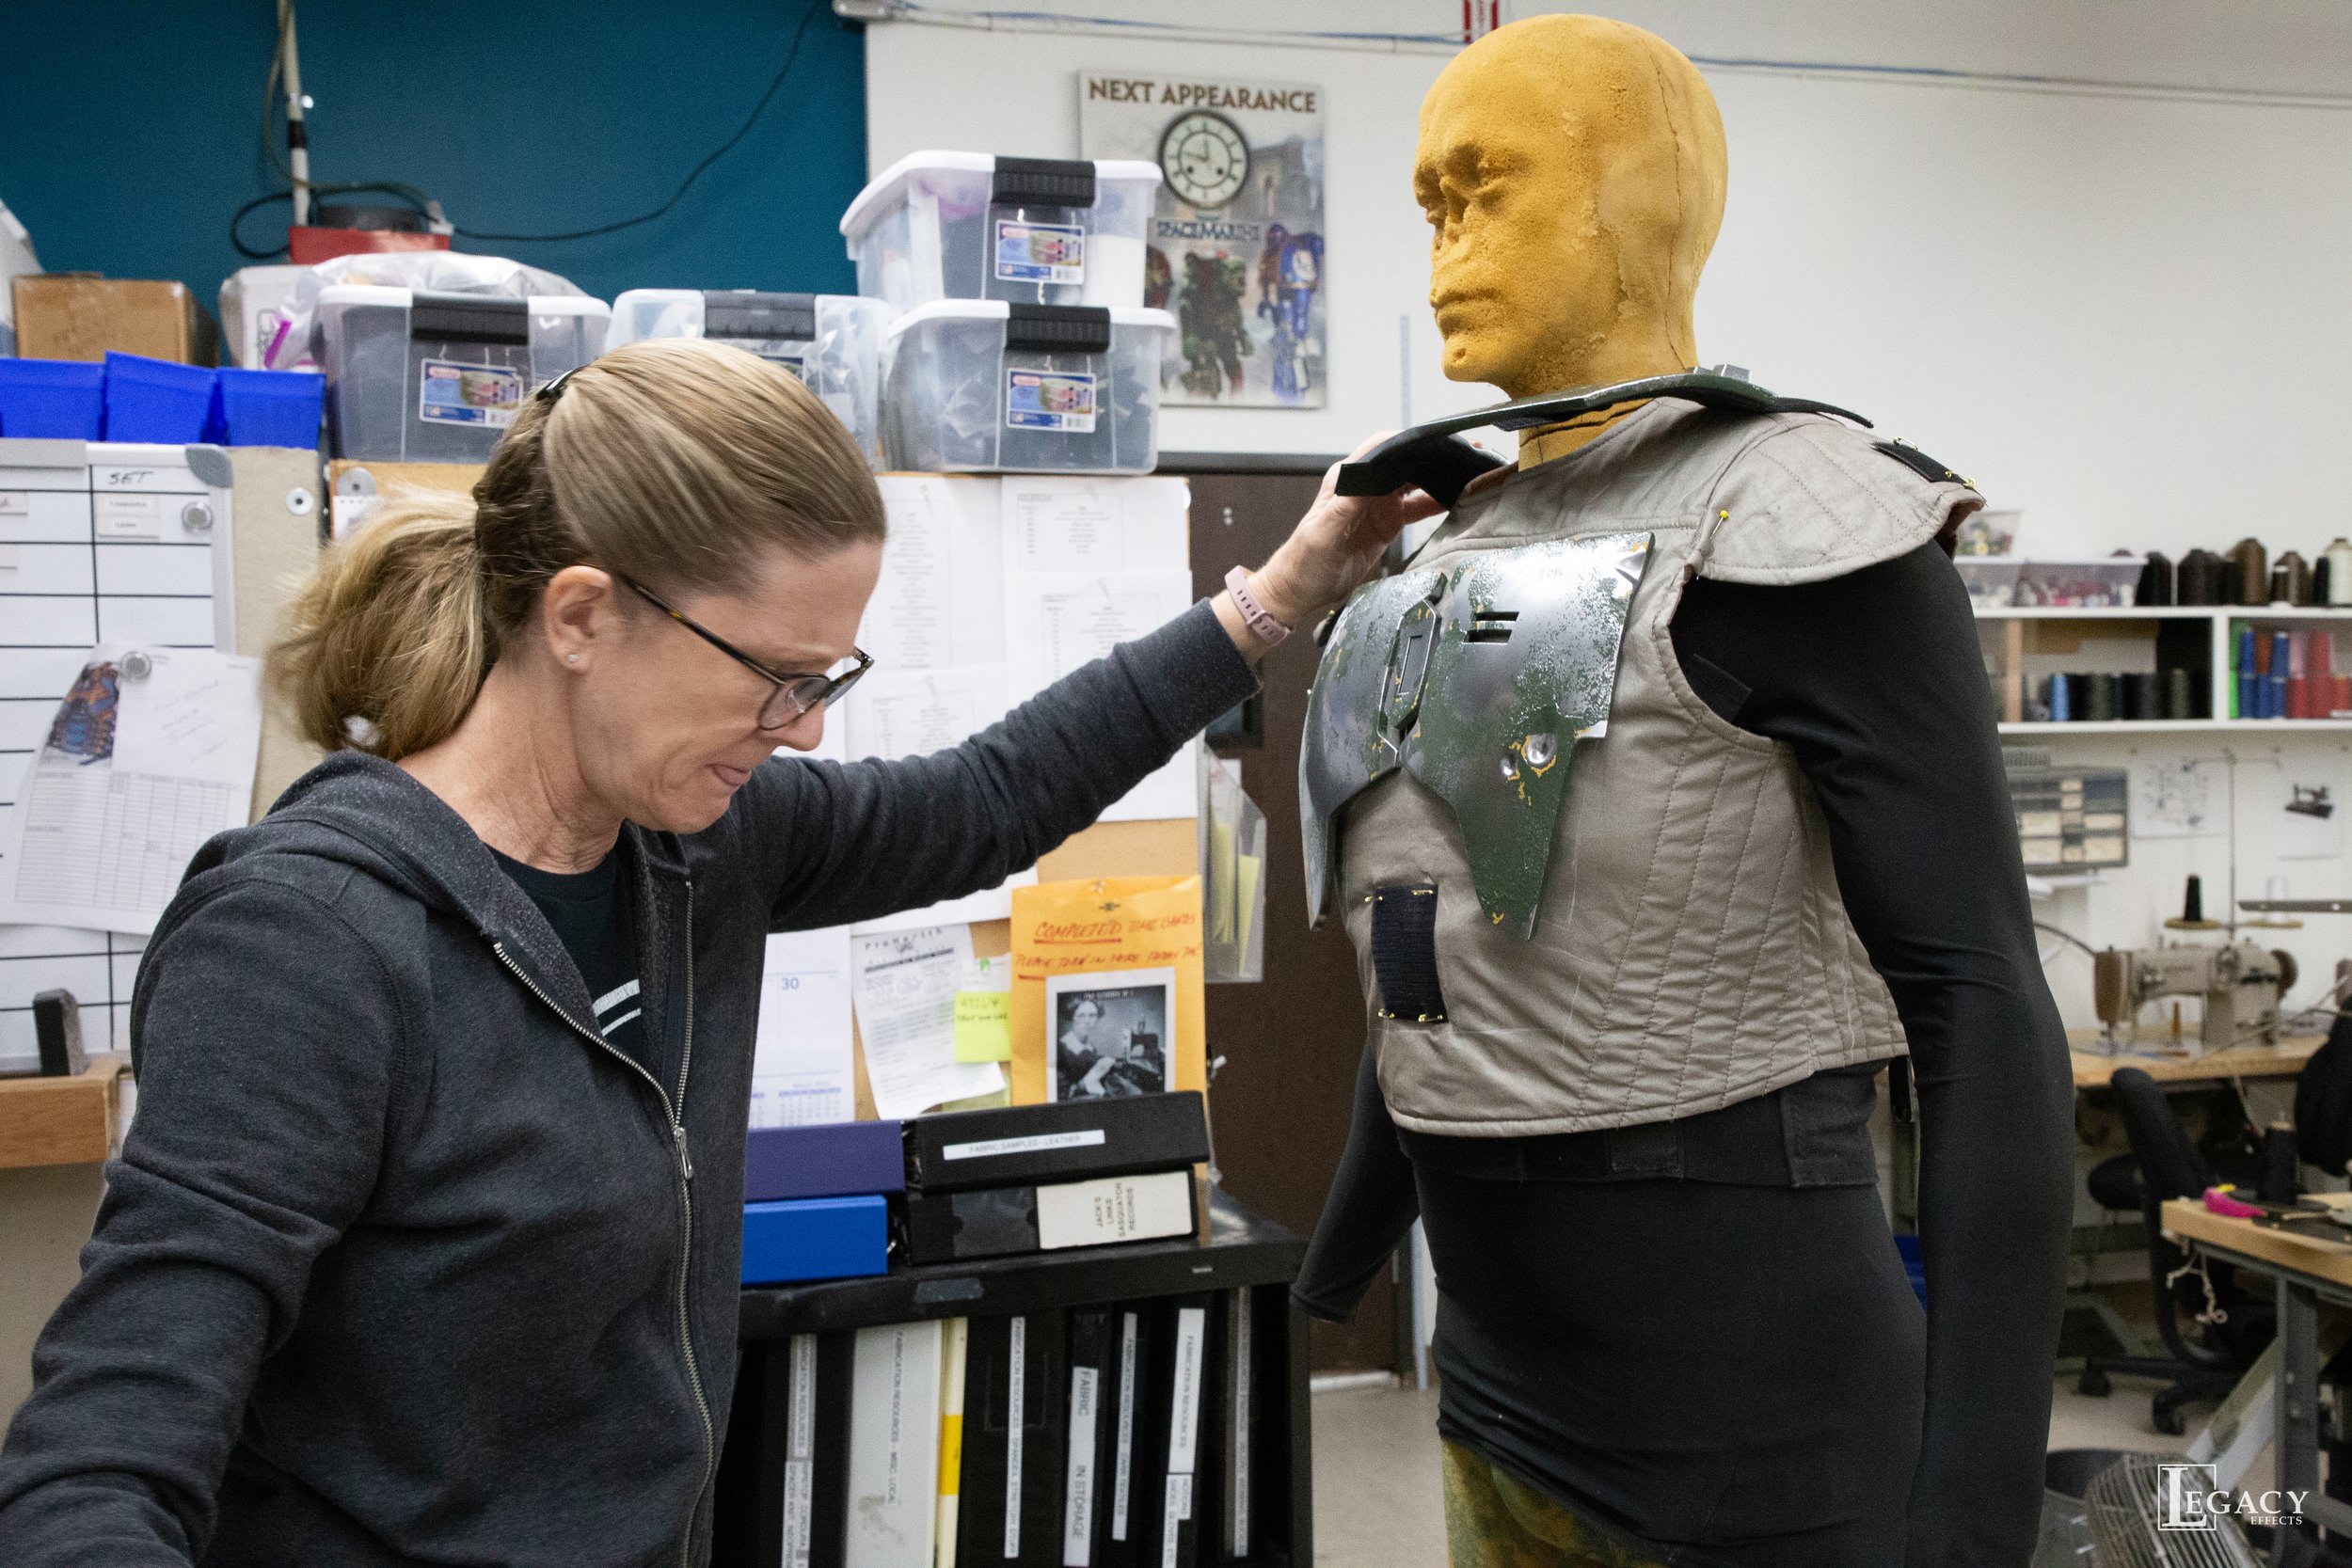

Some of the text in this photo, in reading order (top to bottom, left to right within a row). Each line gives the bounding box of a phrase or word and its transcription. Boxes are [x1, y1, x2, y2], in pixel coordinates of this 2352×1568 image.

[1089, 79, 1316, 113] NEXT APPEARANCE
[108, 470, 154, 485] SET
[1034, 918, 1122, 940] COMPLETED
[781, 976, 800, 990] 30
[1115, 1181, 1127, 1238] SASQUATCH
[1073, 1370, 1091, 1541] FABRIC IN STORAGE
